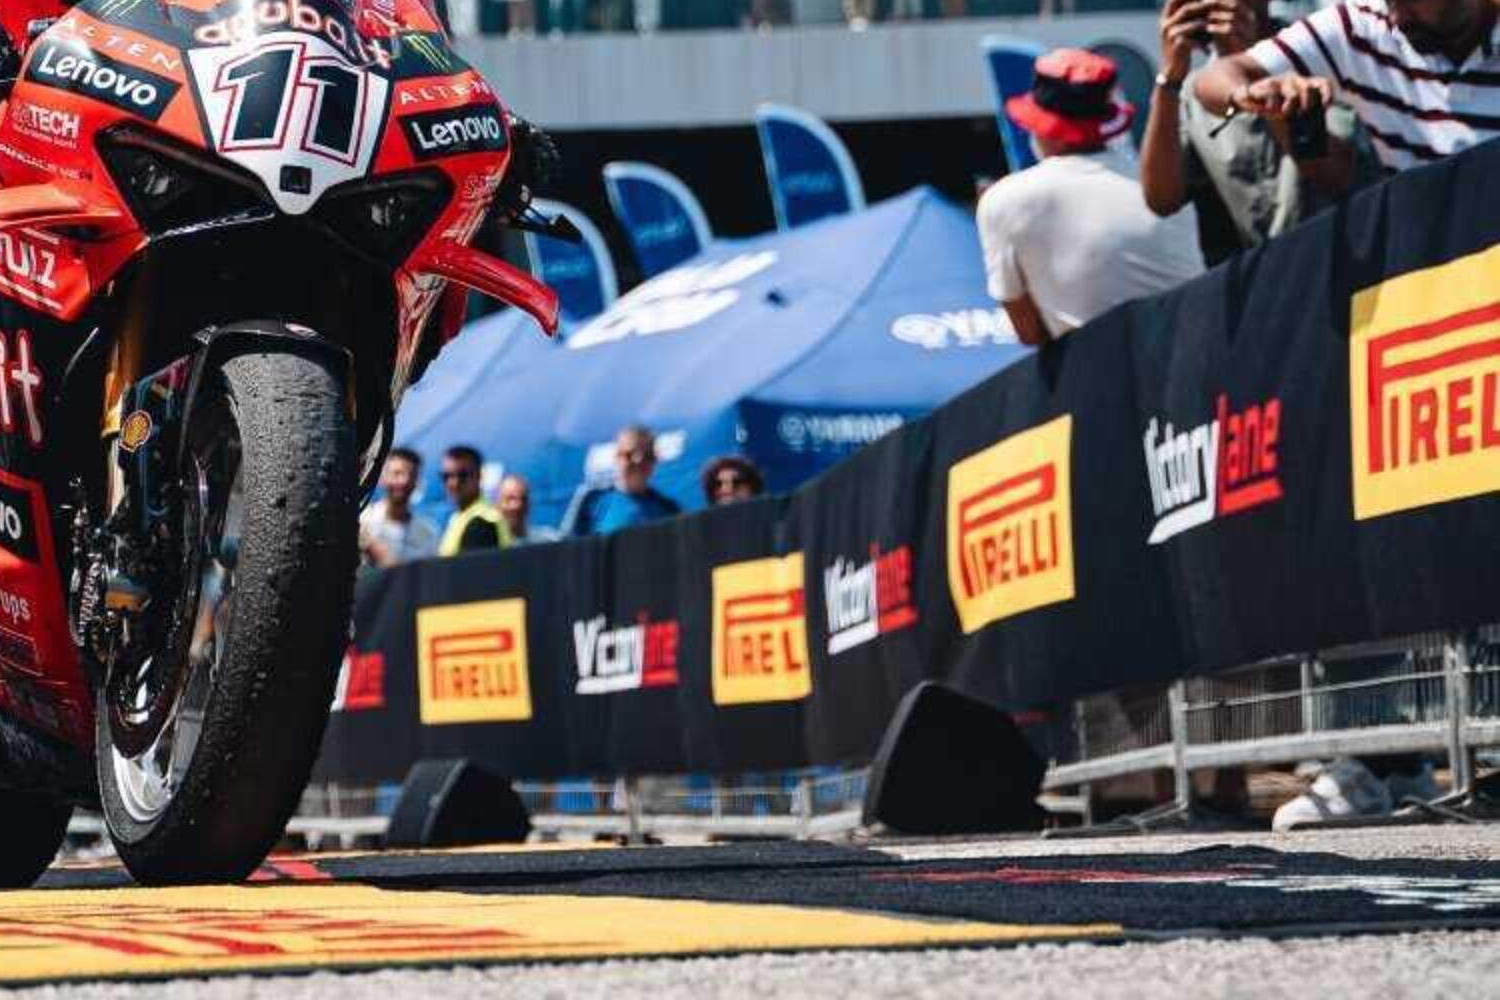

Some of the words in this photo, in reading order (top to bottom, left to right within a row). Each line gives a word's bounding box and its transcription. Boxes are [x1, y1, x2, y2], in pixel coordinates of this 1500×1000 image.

[37, 47, 158, 106] Lenovo
[212, 41, 370, 168] 11
[412, 114, 500, 150] Lenovo
[1367, 302, 1500, 475] PIREL
[958, 461, 1059, 600] PIRELLI
[429, 629, 518, 702] PIRELLI
[723, 588, 806, 680] PIREL
